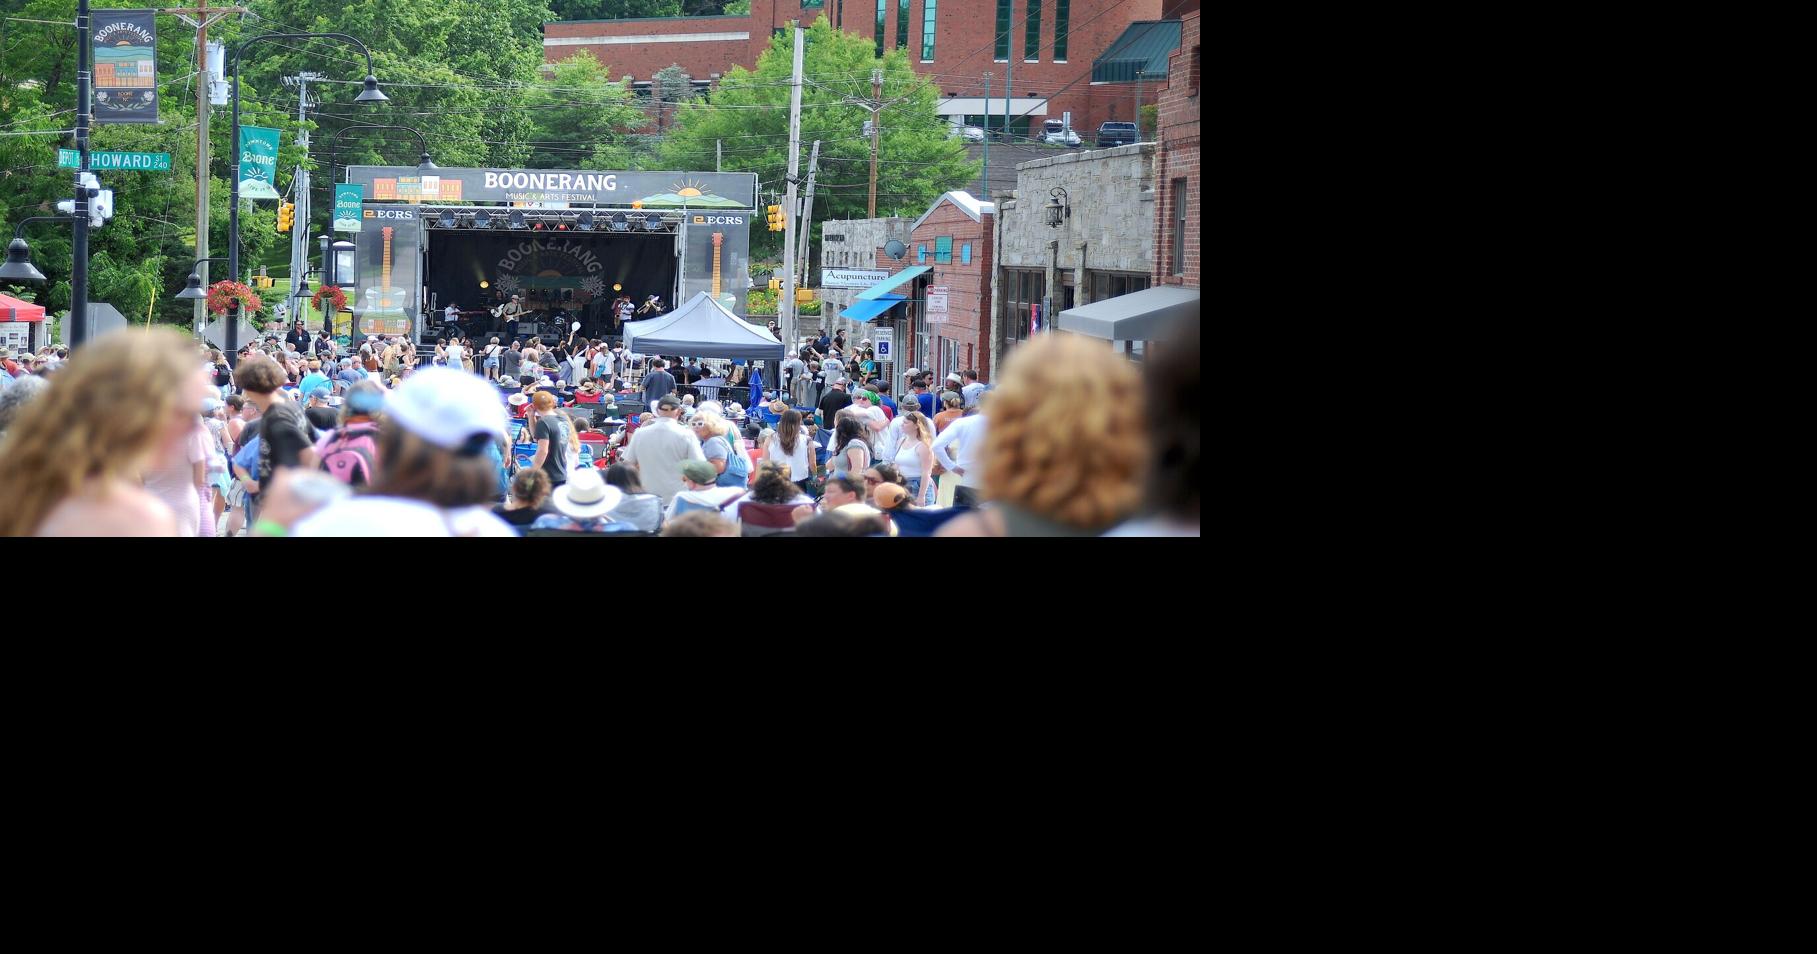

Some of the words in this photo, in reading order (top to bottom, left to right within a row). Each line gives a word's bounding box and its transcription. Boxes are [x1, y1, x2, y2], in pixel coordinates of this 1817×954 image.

[94, 22, 153, 43] BOONERANG
[58, 150, 74, 165] DEPOT
[91, 153, 151, 168] HOWARD
[484, 172, 617, 191] BOONERANG
[505, 192, 530, 200] MUSIC
[562, 193, 597, 201] FESTIVAL
[377, 210, 413, 219] ECRS
[707, 216, 743, 225] ECRS
[825, 270, 886, 281] Acupuncture
